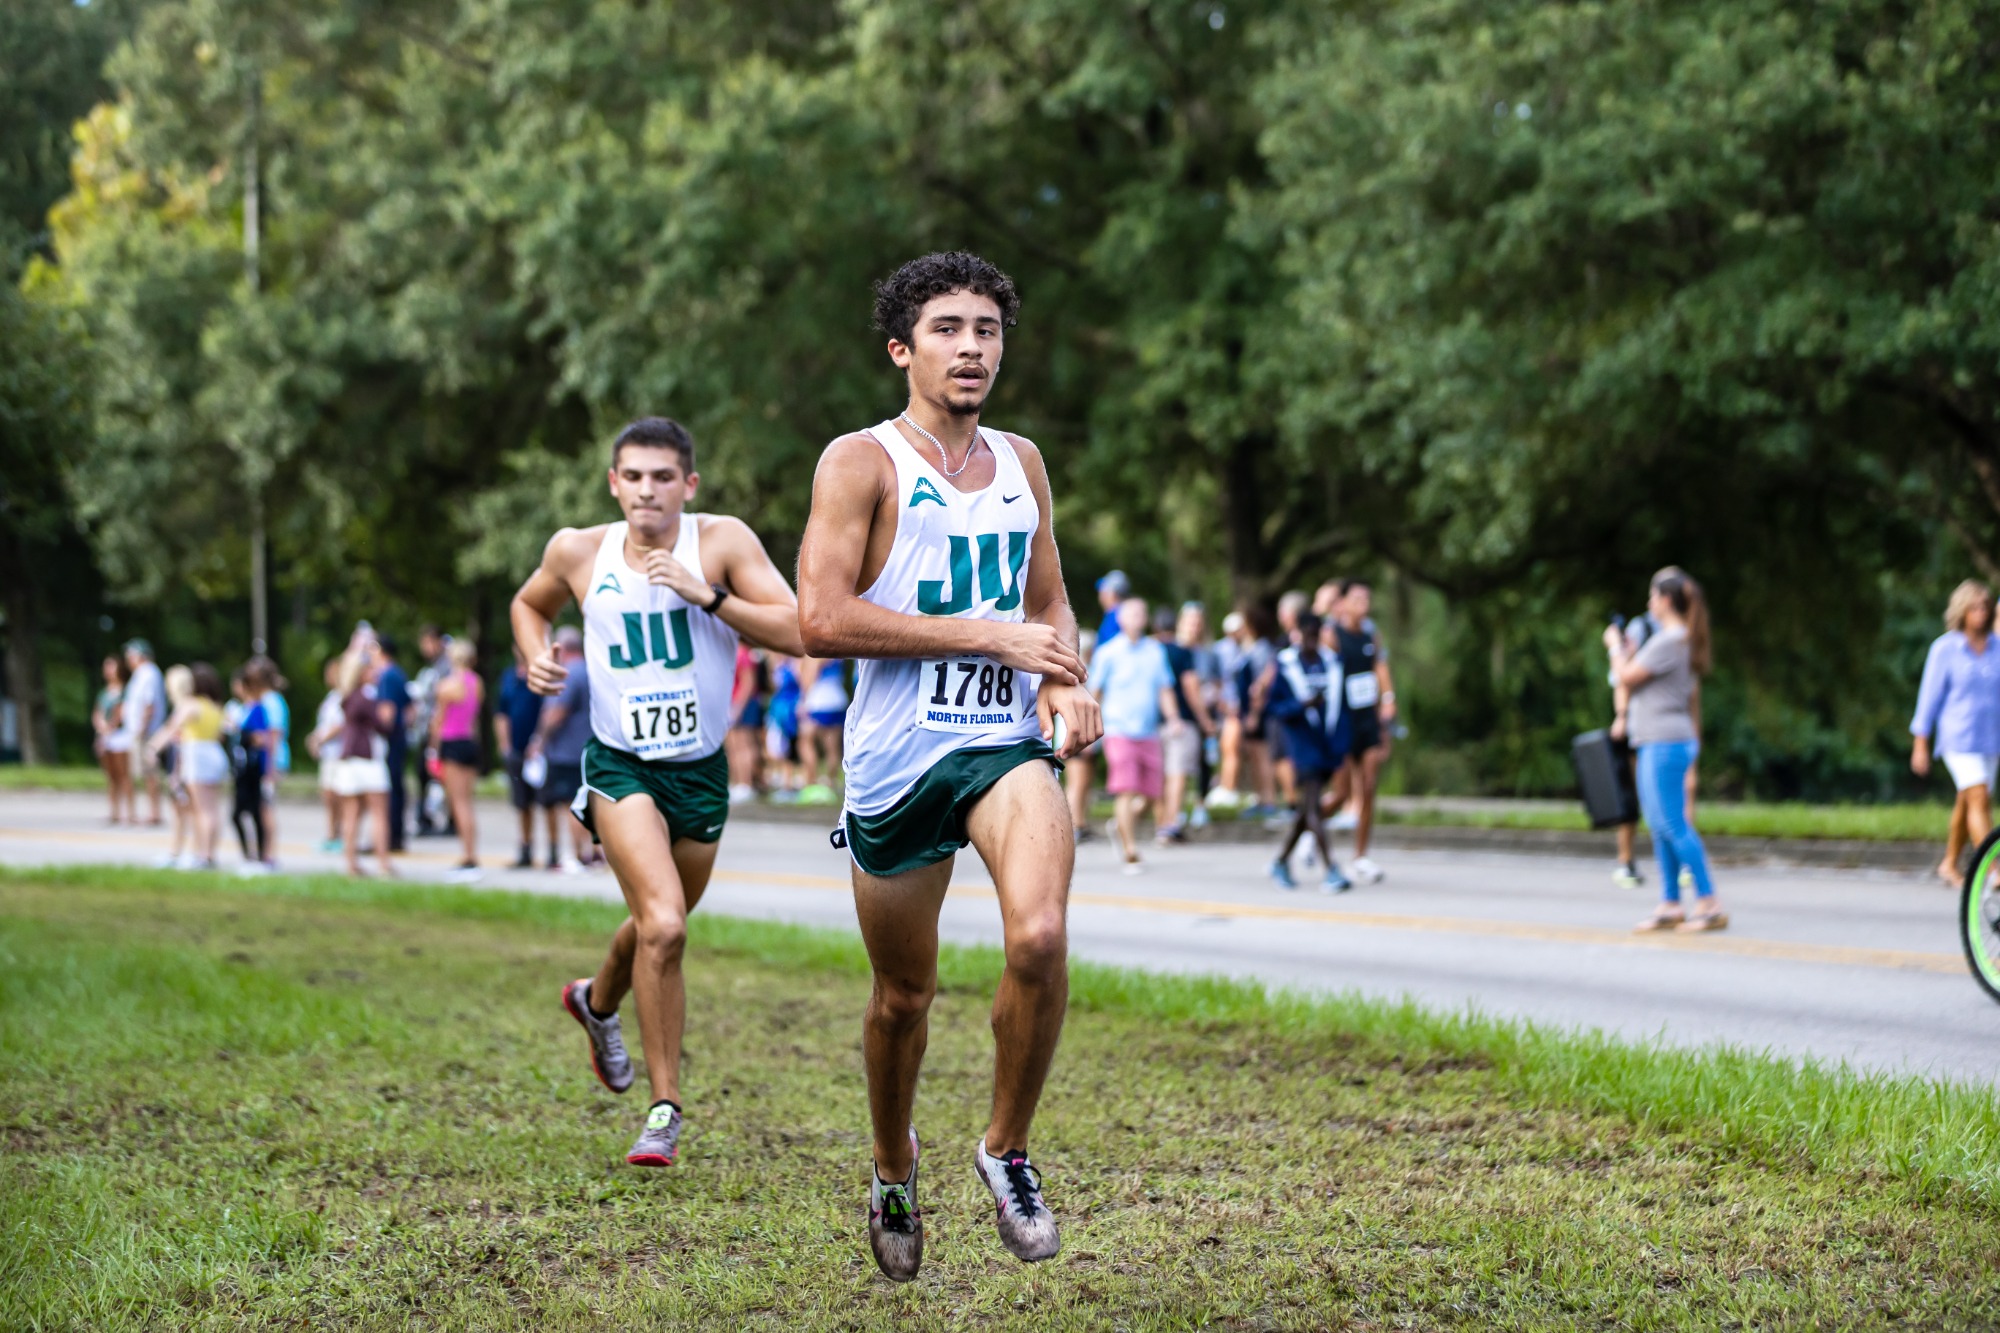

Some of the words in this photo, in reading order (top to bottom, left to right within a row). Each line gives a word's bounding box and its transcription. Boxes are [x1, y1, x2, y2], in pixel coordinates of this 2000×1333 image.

[918, 531, 1029, 616] JU
[608, 607, 694, 670] JU
[930, 661, 1014, 708] 1788
[630, 701, 697, 740] 1785
[926, 710, 968, 725] NORTH
[969, 713, 1014, 725] FLORIDA
